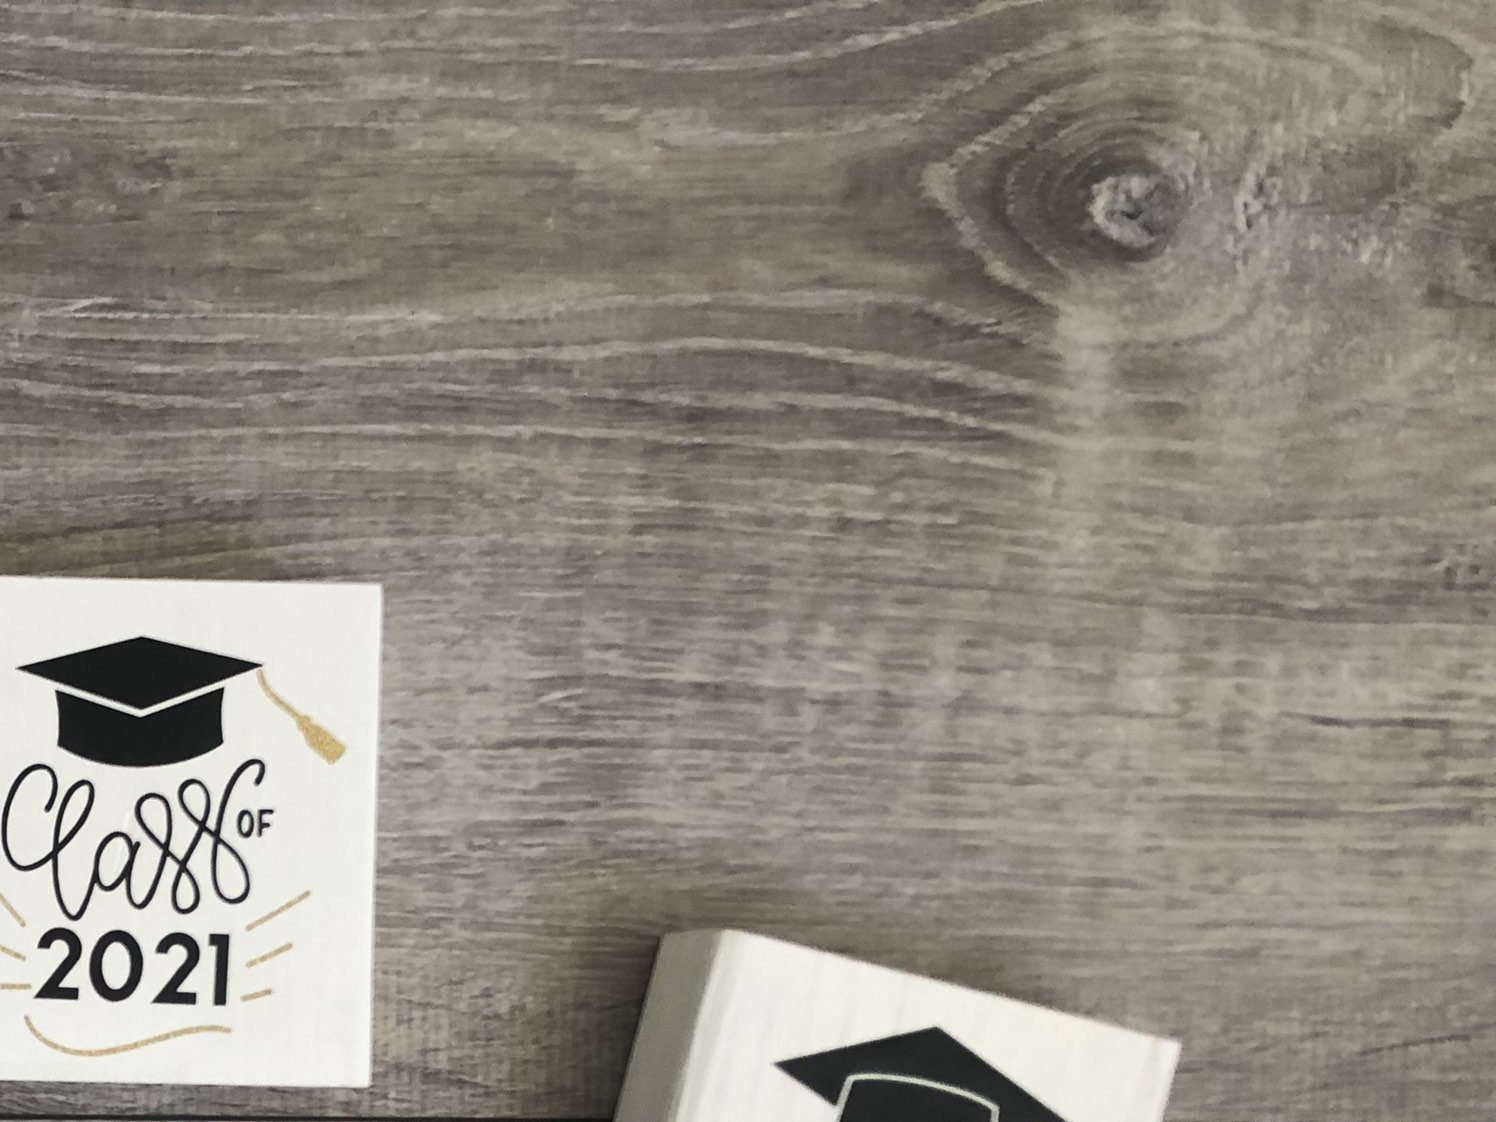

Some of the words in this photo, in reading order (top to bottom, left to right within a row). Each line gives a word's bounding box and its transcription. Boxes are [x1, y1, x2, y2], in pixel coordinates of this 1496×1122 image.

[0, 757, 266, 922] Class
[235, 808, 275, 839] OF
[33, 926, 231, 1006] 2021
